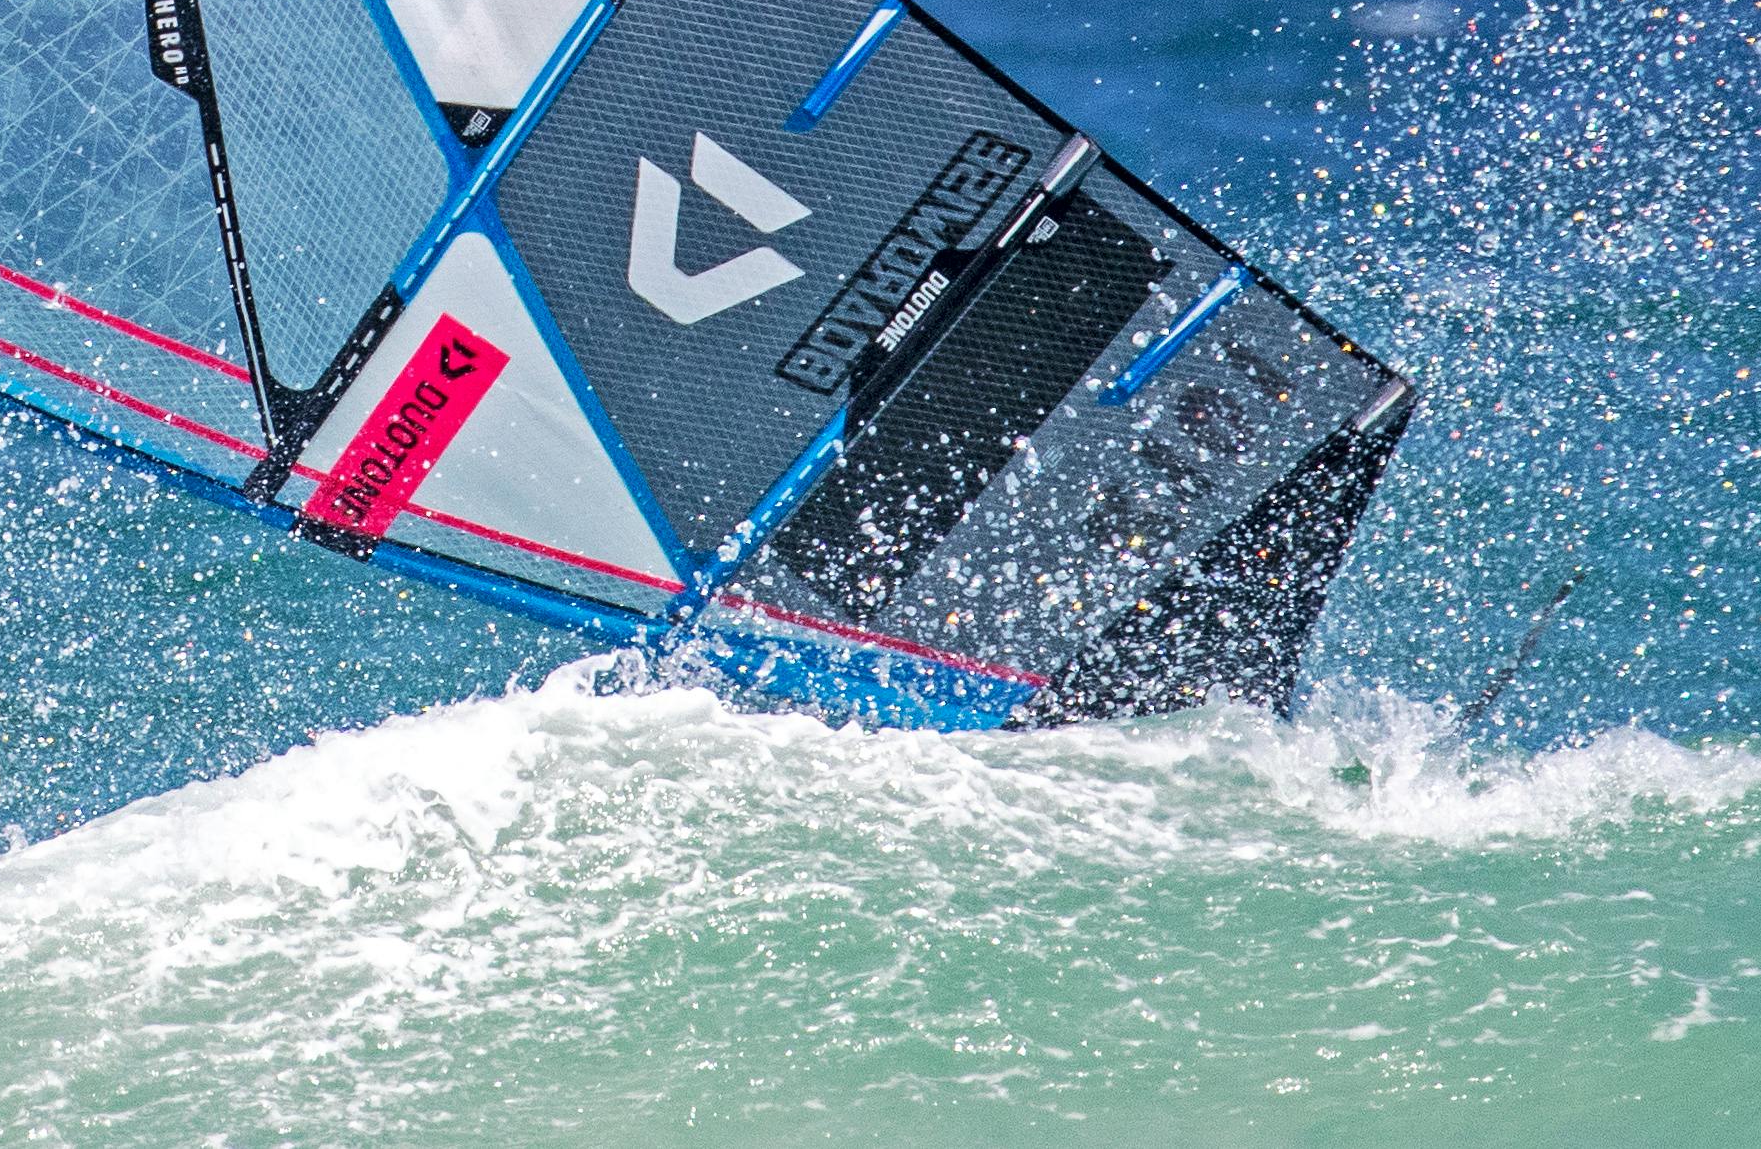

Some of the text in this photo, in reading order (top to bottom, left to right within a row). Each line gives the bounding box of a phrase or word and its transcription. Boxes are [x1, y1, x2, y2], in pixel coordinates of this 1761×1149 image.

[154, 0, 184, 63] HERO
[173, 66, 189, 85] HD
[875, 270, 950, 351] DUOTONE
[336, 381, 448, 523] DUOTONE
